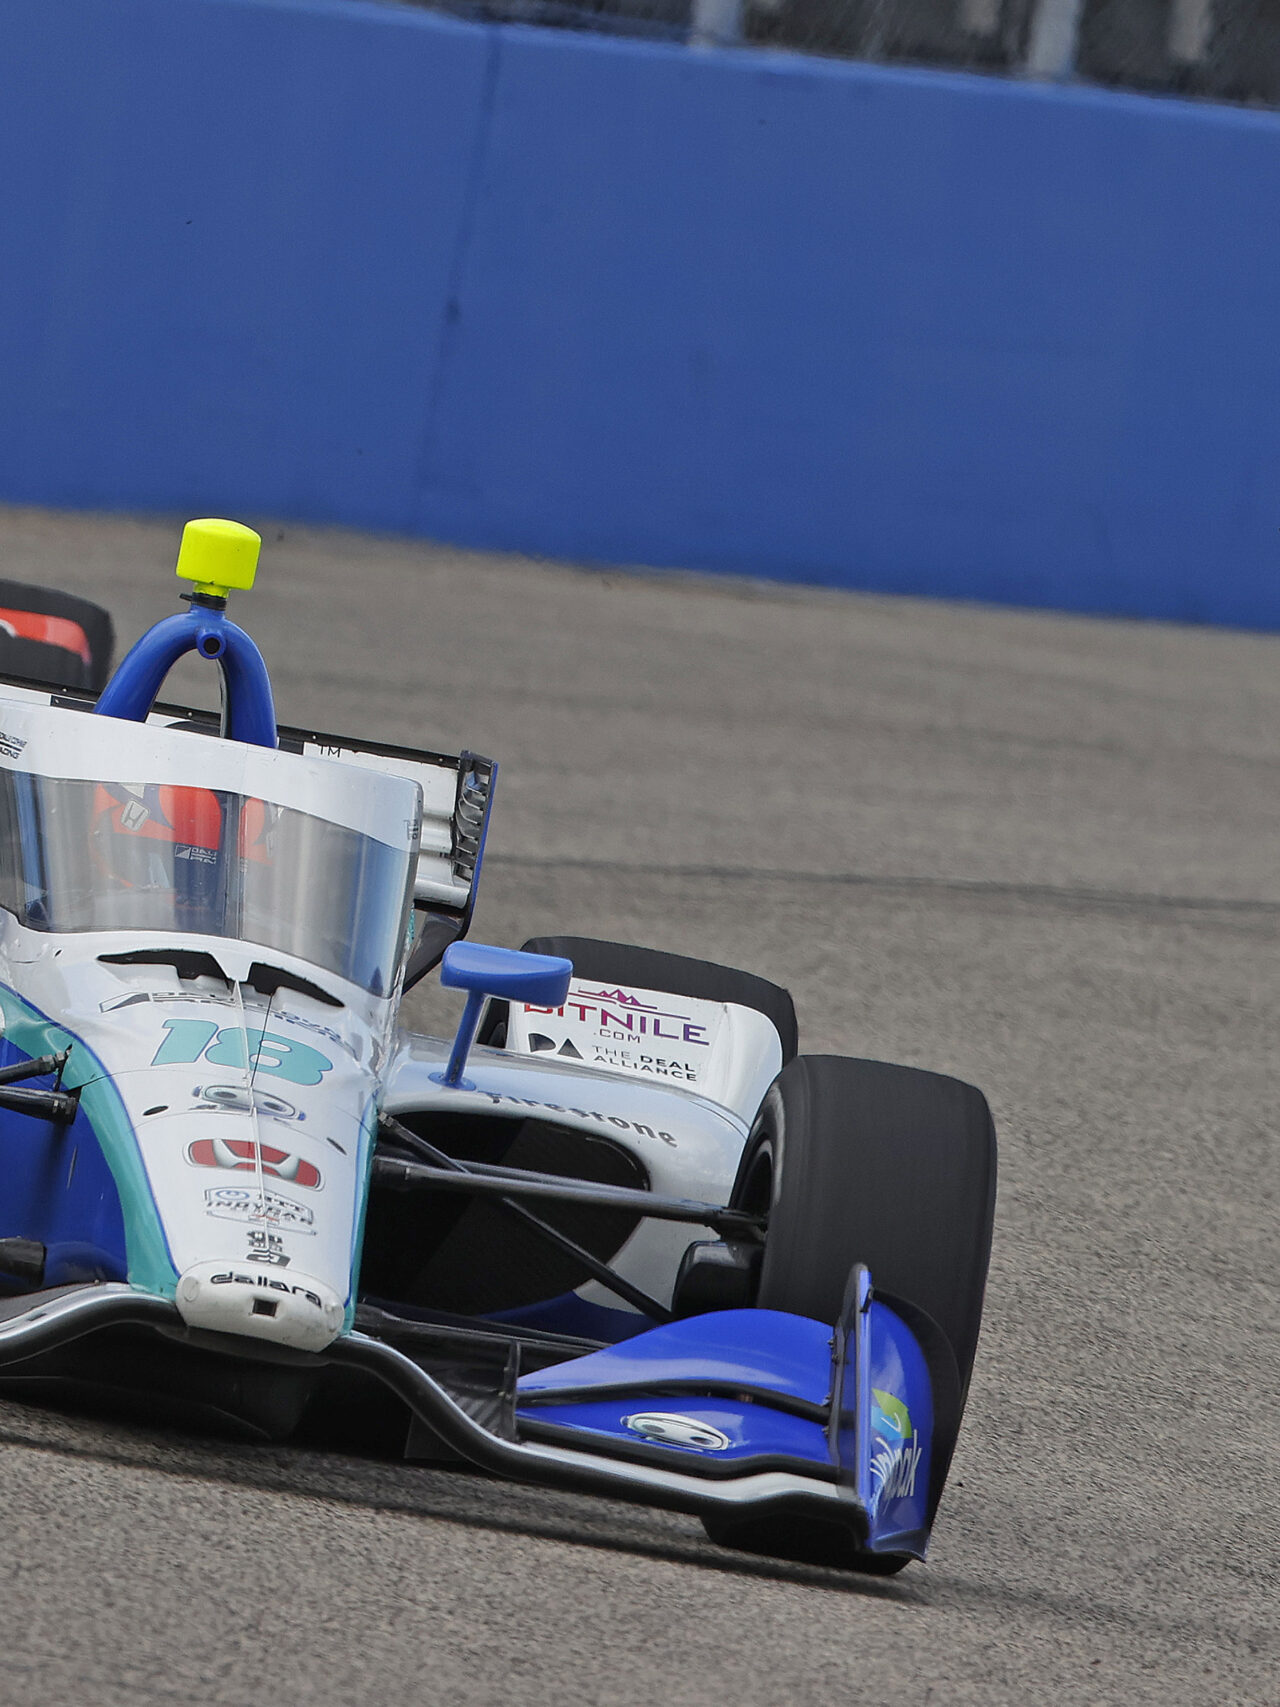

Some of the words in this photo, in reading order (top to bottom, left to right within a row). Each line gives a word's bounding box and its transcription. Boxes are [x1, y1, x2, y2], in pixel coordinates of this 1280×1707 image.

[150, 1019, 334, 1086] 18
[592, 1044, 632, 1059] THE
[639, 1055, 696, 1073] DEAL
[593, 1055, 697, 1082] ALLIANCE
[478, 1090, 679, 1149] Firestone
[206, 1200, 313, 1226] INDYCAR
[210, 1271, 322, 1309] dallara
